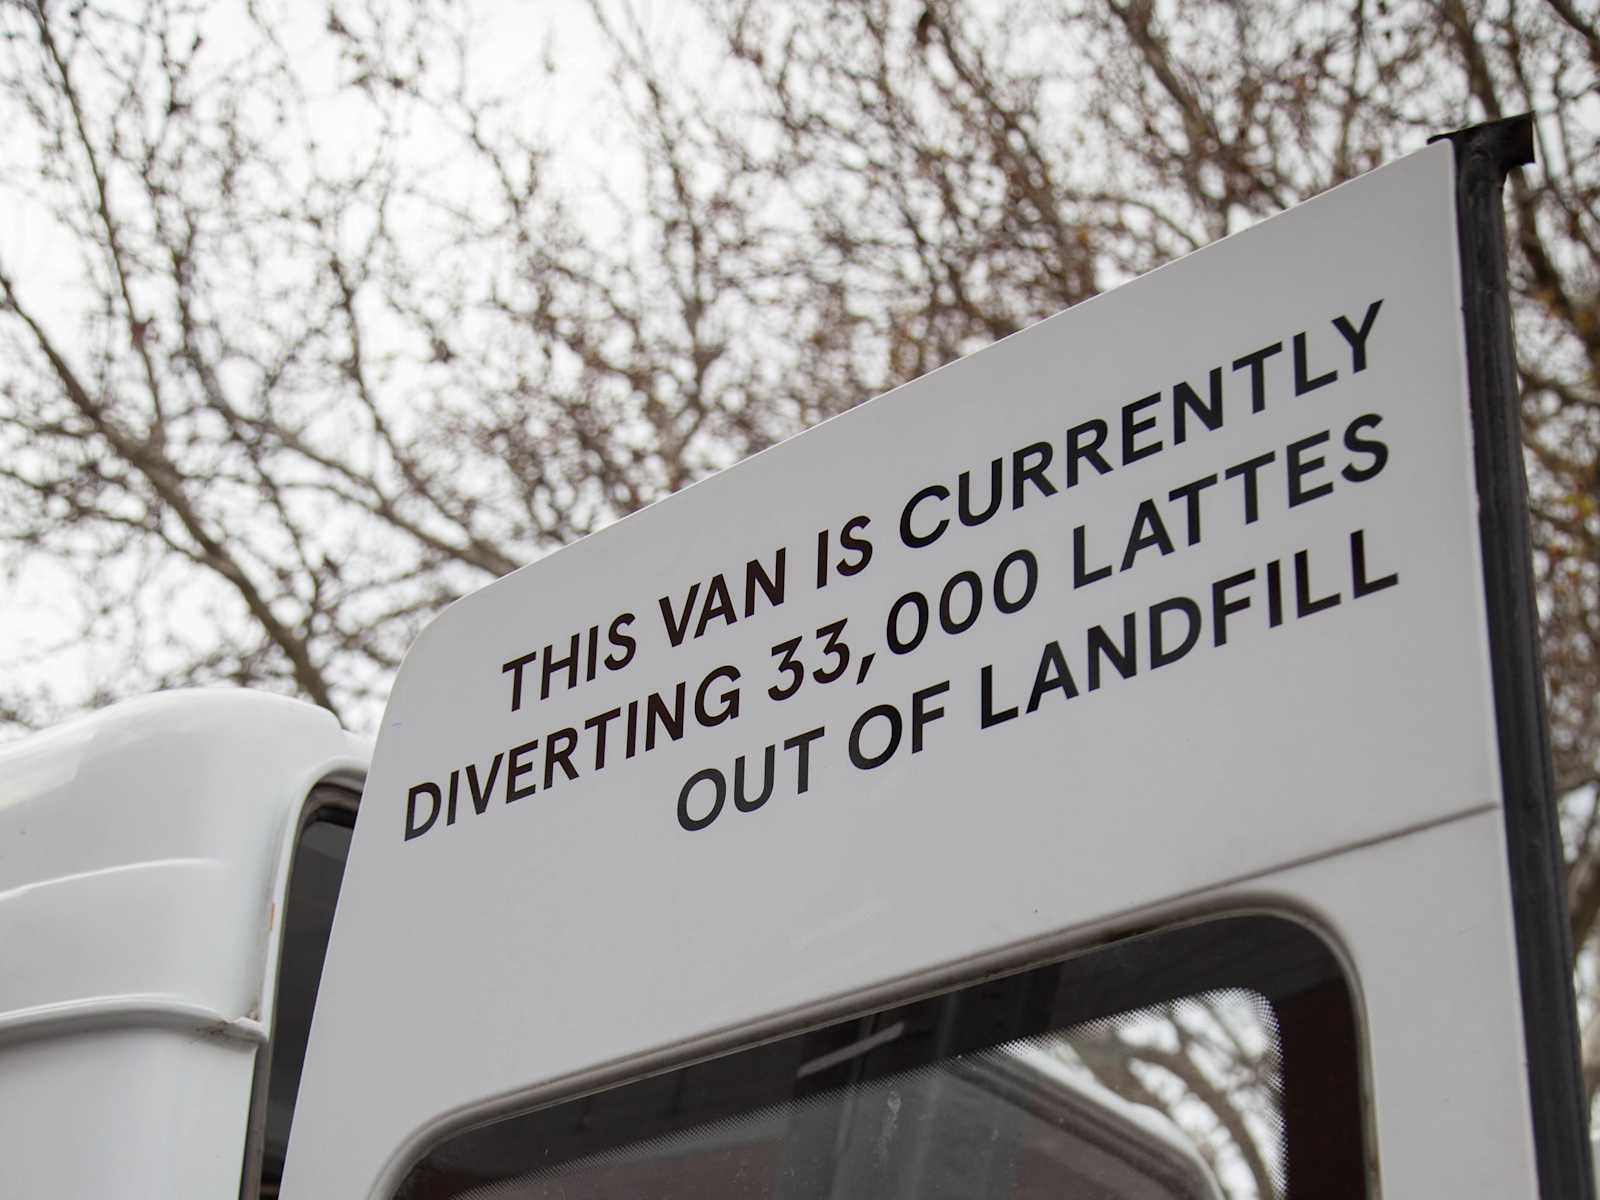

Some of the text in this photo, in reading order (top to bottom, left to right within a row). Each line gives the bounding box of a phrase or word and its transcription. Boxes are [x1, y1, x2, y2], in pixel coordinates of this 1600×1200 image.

[403, 413, 1389, 842] DIVERTING 33,000 LATTES
[502, 298, 1385, 713] THIS VAN IS CURRENTLY
[676, 528, 1399, 832] OUT OF LANDFILL
